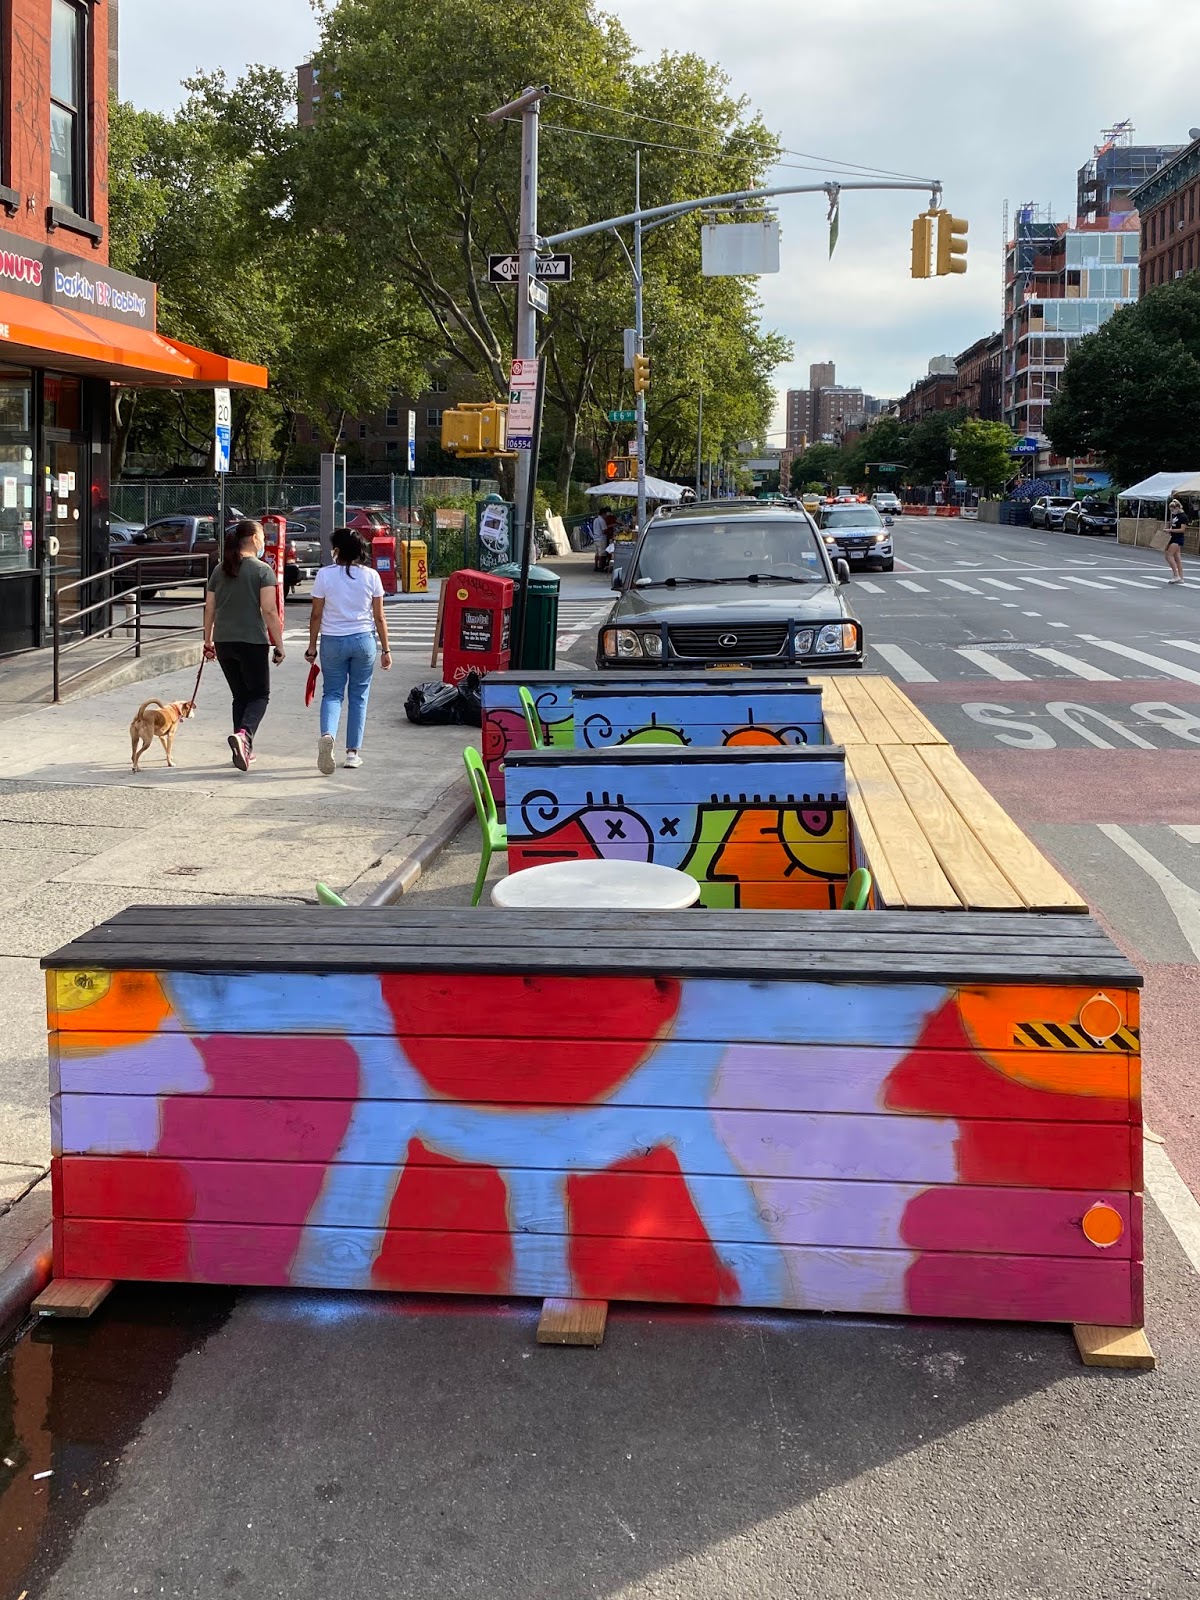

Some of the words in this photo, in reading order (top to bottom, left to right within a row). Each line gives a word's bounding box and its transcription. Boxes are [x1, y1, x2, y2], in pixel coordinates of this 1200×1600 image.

[501, 263, 519, 274] ON
[536, 262, 560, 274] WAY
[512, 391, 519, 403] 2
[218, 405, 229, 421] 20
[613, 412, 618, 420] E
[620, 412, 625, 420] 6
[507, 439, 531, 448] 106554
